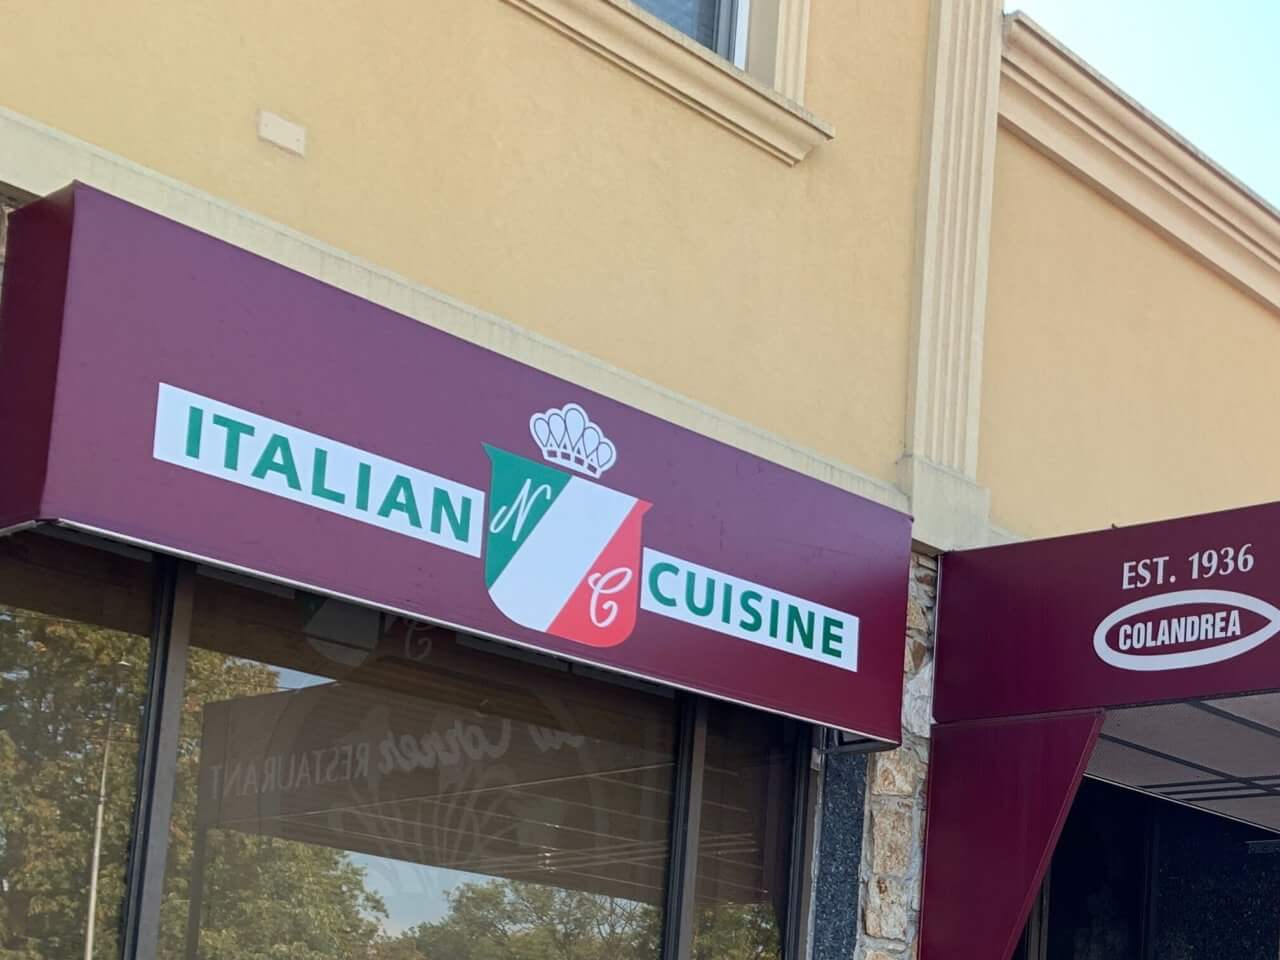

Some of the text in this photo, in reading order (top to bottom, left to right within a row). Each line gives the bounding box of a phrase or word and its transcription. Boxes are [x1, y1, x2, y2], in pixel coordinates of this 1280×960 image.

[185, 406, 472, 544] ITALIAN
[489, 478, 551, 542] N
[1121, 544, 1255, 590] EST. 1936
[648, 562, 845, 658] CUISINE
[1118, 610, 1242, 650] COLANDREA
